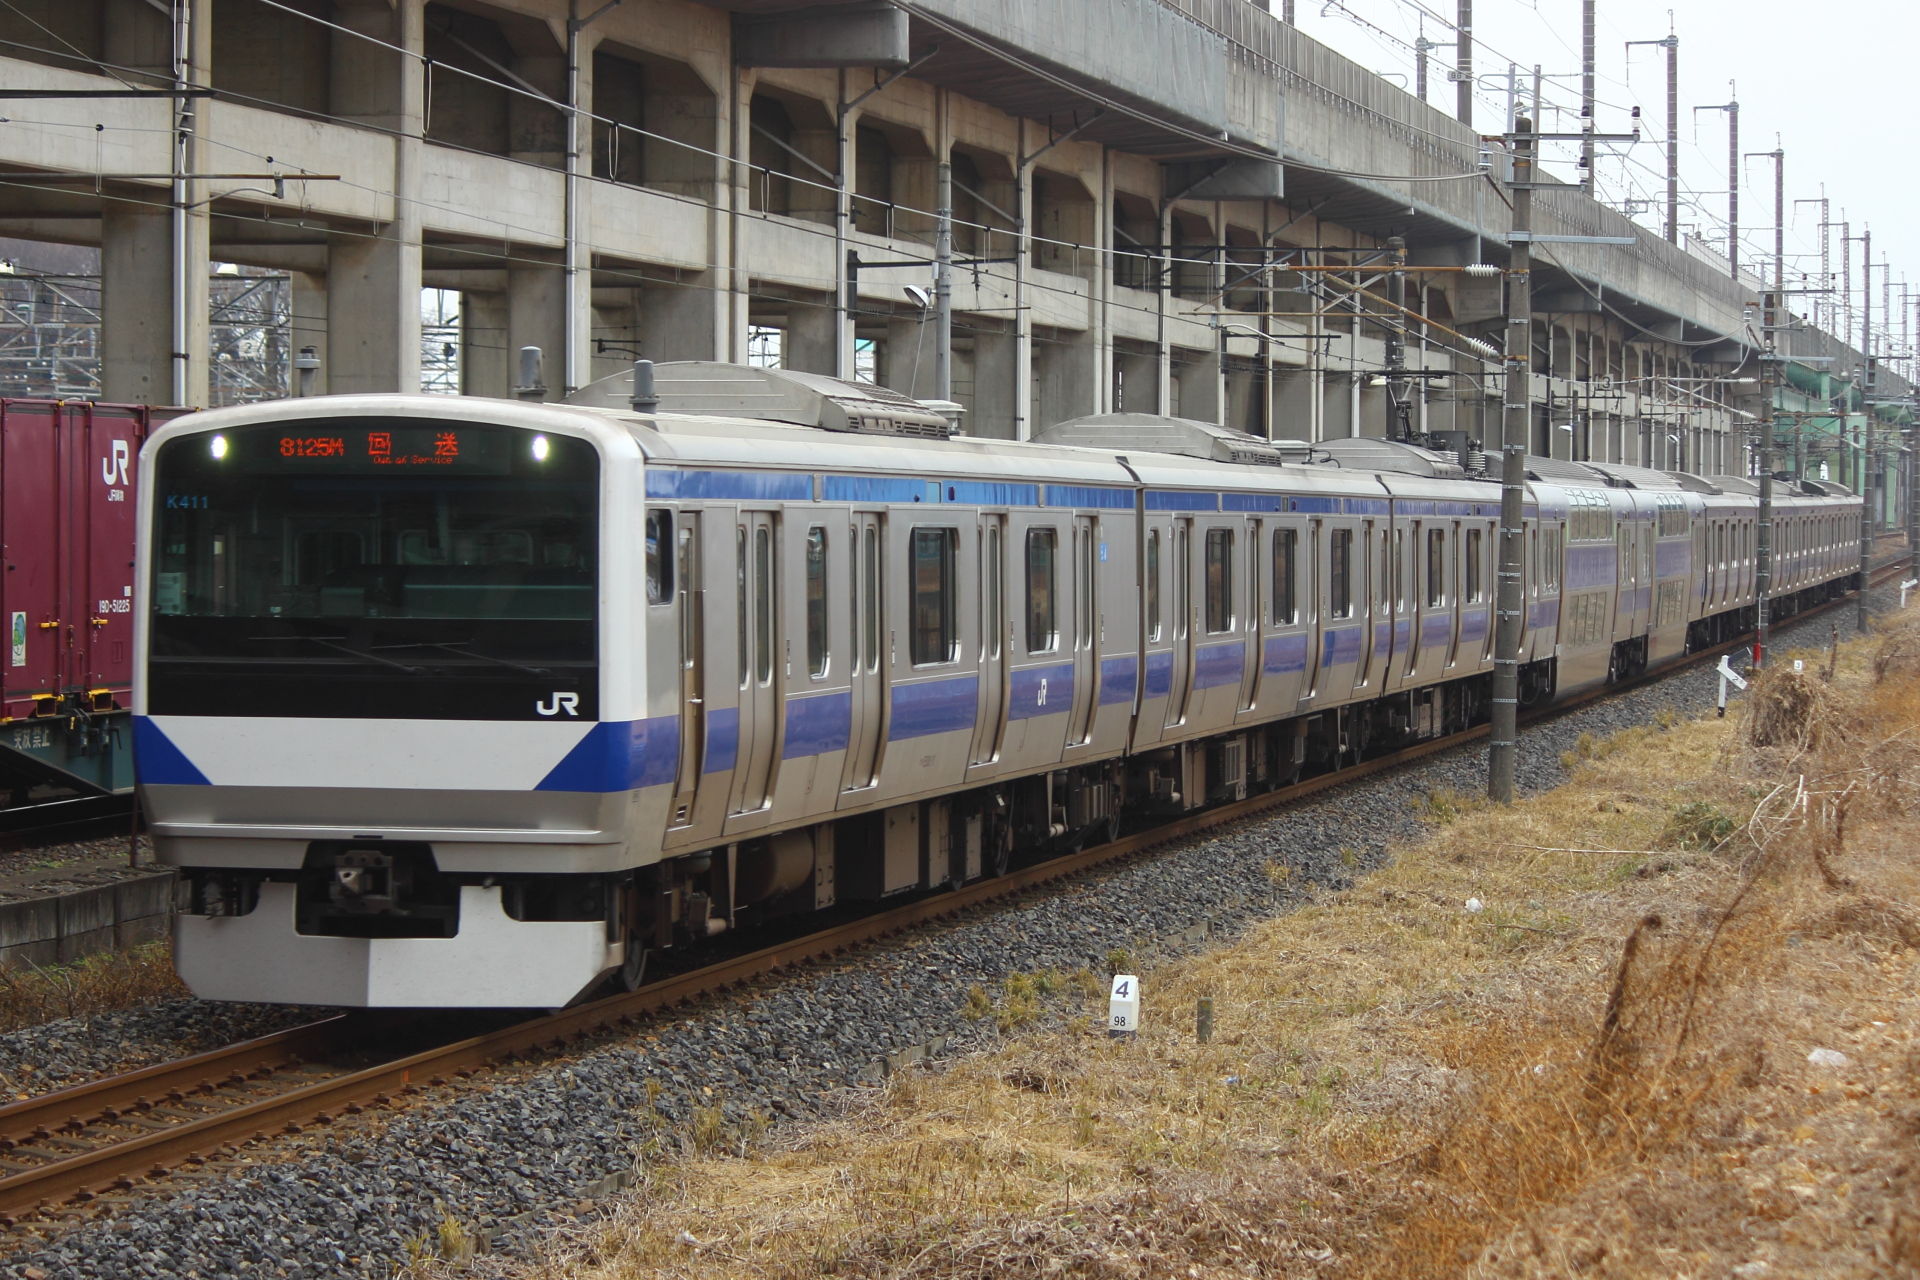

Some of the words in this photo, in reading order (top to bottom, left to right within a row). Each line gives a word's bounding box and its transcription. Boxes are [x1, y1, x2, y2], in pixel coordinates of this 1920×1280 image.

[280, 438, 344, 456] 8125M
[103, 440, 129, 486] JR
[167, 495, 208, 509] K411
[1038, 679, 1047, 706] JR
[536, 692, 579, 716] JR
[1115, 981, 1129, 998] 4
[1114, 1016, 1126, 1027] 98
